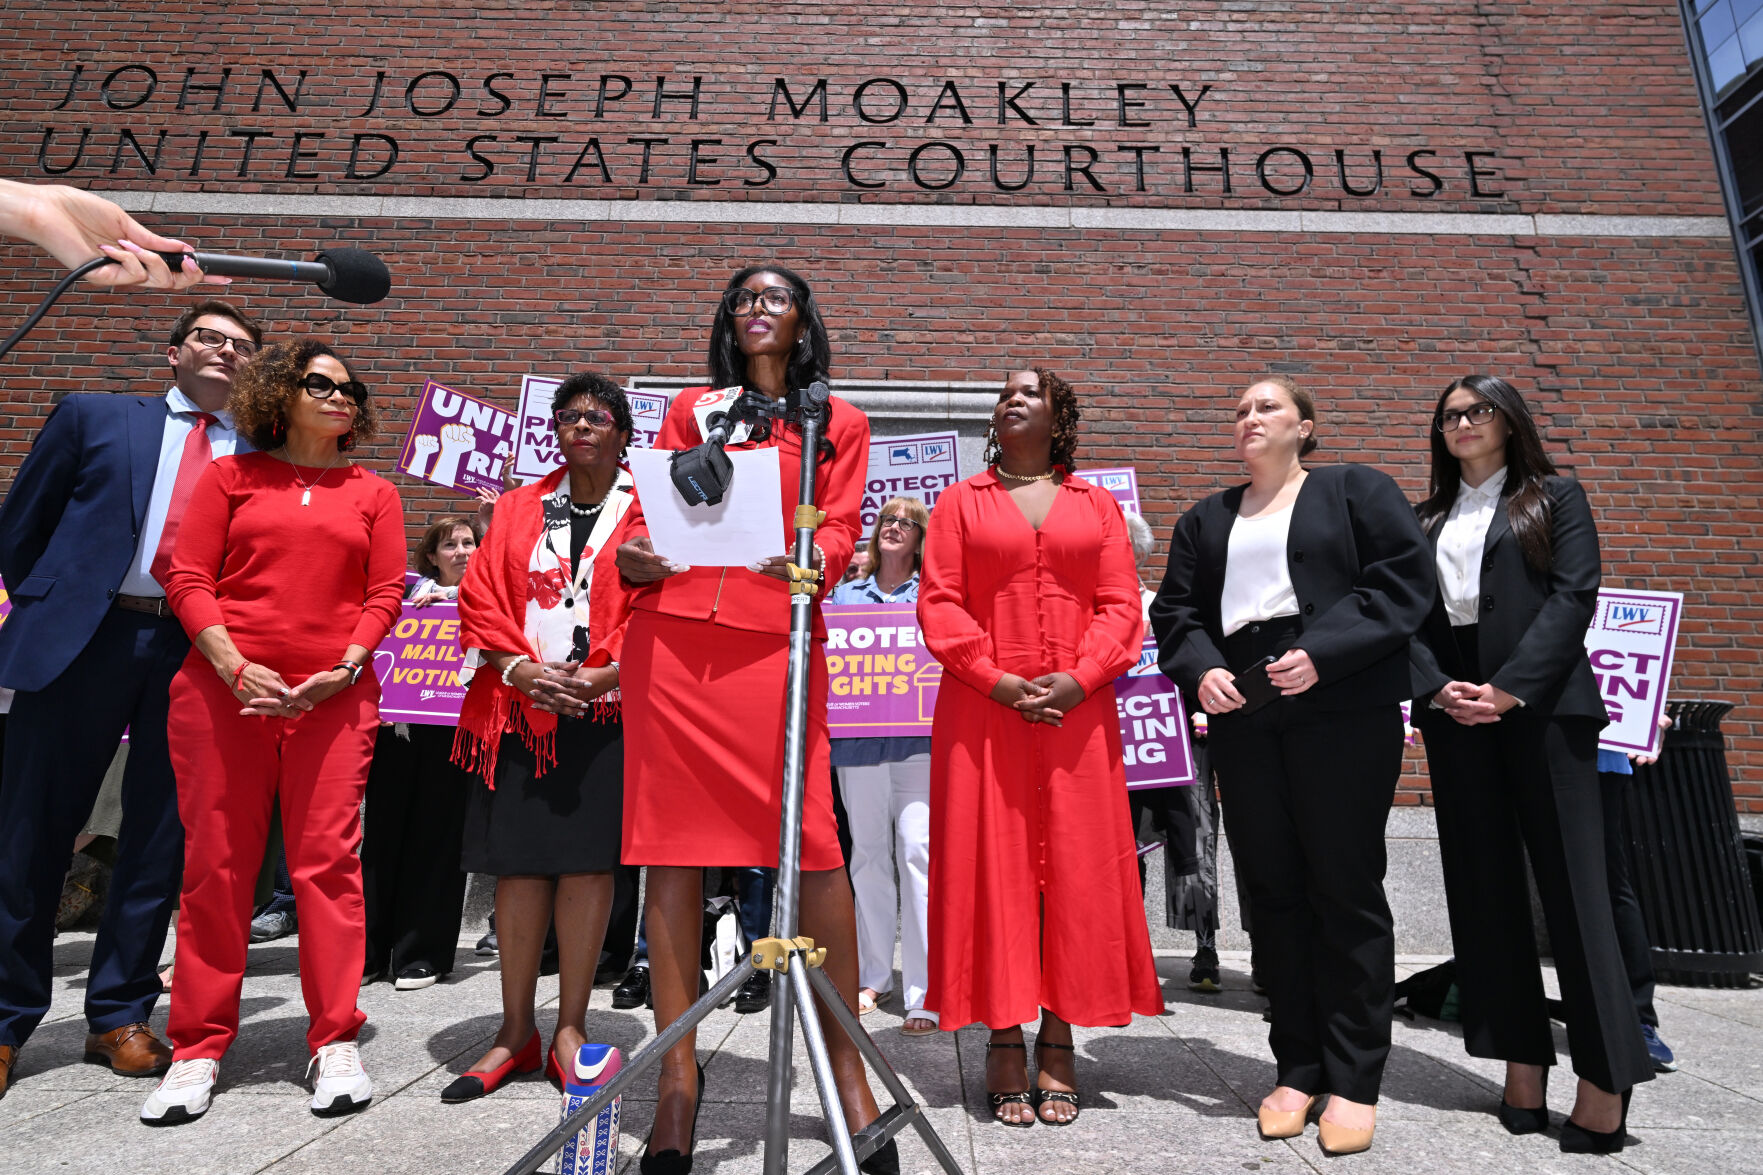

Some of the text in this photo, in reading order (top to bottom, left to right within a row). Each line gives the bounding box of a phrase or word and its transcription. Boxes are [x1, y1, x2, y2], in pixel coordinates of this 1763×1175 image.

[54, 64, 1213, 128] JOHN JOSEPH MOAKLEY
[39, 127, 1505, 199] UNITED STATES COURTHOUSE
[635, 400, 654, 411] LWV
[925, 444, 943, 456] LWV
[864, 473, 955, 494] OTECT
[1611, 606, 1650, 621] LWV
[384, 618, 462, 641] OTE
